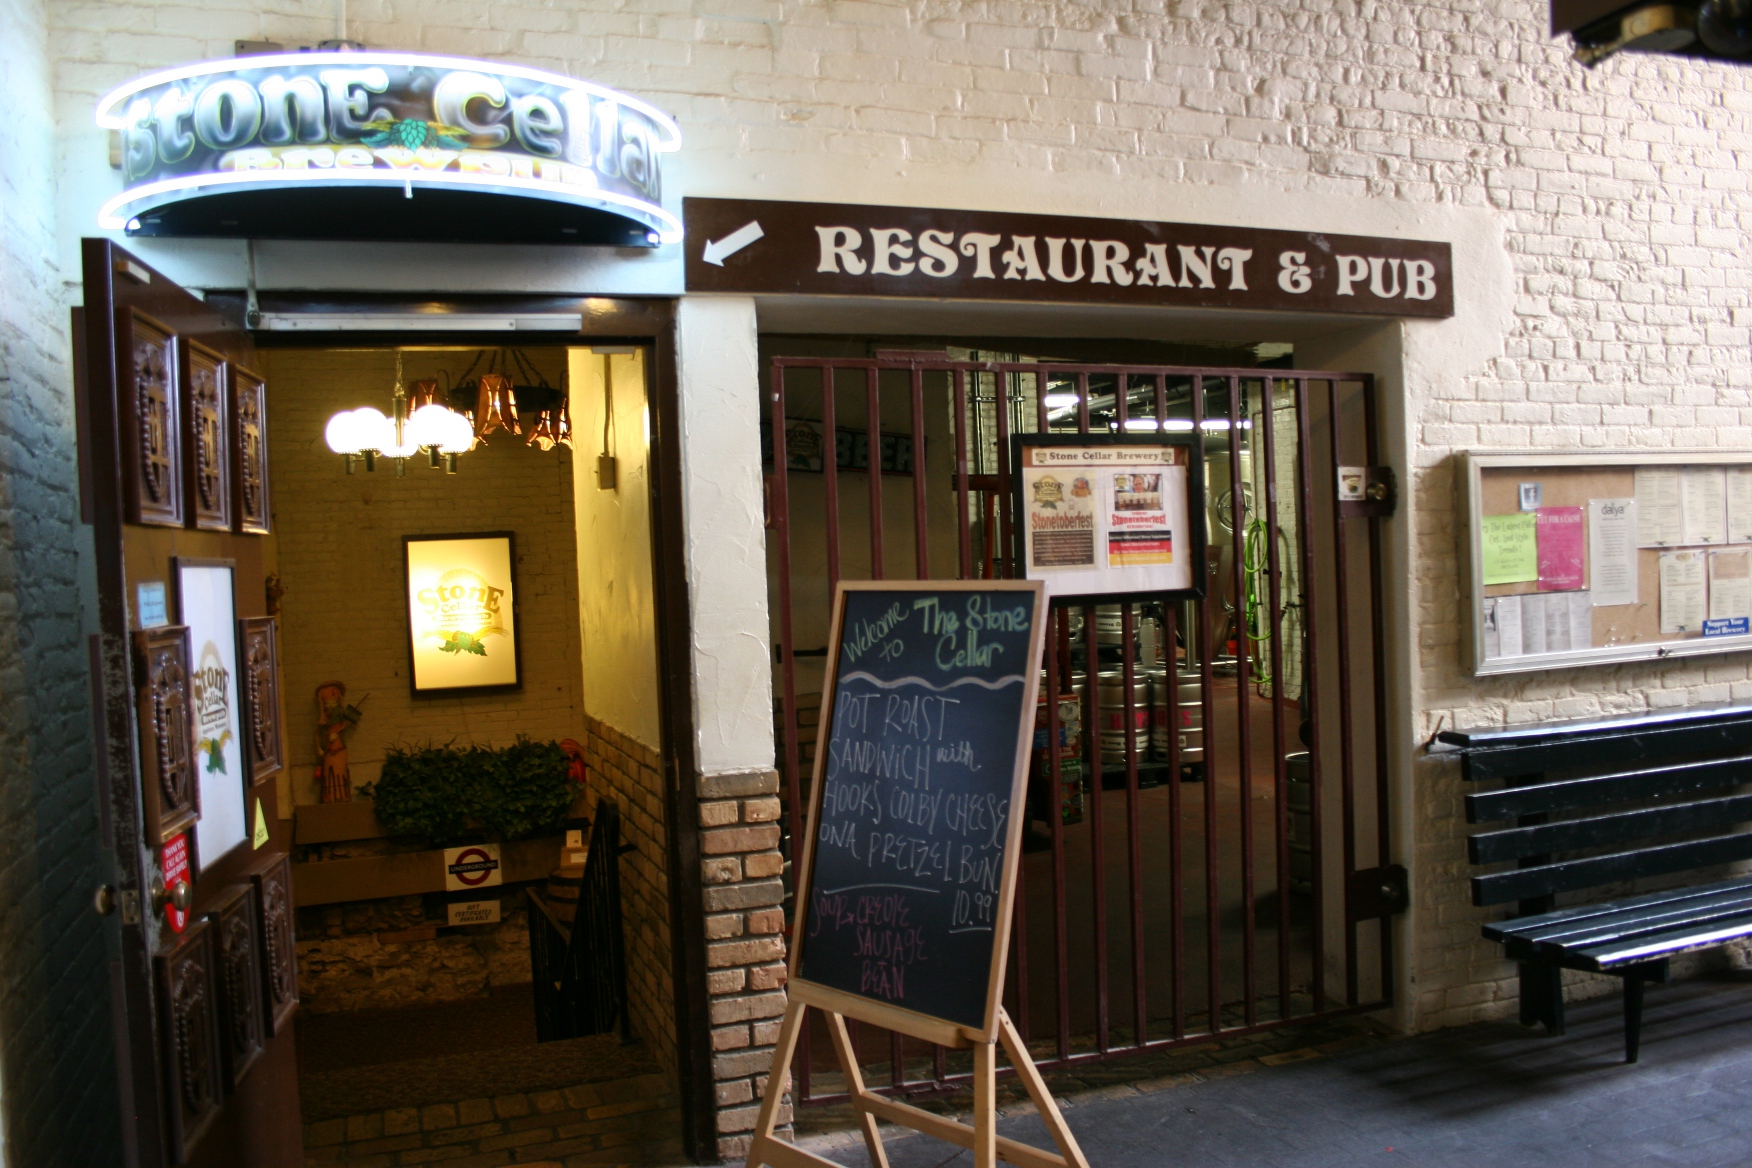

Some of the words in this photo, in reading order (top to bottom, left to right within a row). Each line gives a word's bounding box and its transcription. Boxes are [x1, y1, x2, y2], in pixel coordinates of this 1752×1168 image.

[815, 225, 1253, 292] RESTAURANT
[1277, 251, 1313, 294] &
[1336, 253, 1437, 302] PUB
[1049, 451, 1079, 460] Stone
[1082, 451, 1113, 460] Cellar
[1116, 451, 1160, 461] Brewery
[1032, 511, 1093, 530] Stonetoberfest
[843, 602, 909, 662] Welcome
[879, 639, 904, 662] to
[913, 597, 960, 634] The
[965, 595, 1029, 631] Stone
[935, 631, 1004, 671] Cellar
[837, 691, 881, 737] POT
[883, 695, 960, 741] ROAST
[890, 786, 944, 835] COLBY
[946, 793, 1008, 849] CHEESE
[450, 861, 497, 873] UNDERGROUND
[868, 832, 953, 881] PRETZEL
[952, 889, 993, 926] 10.99
